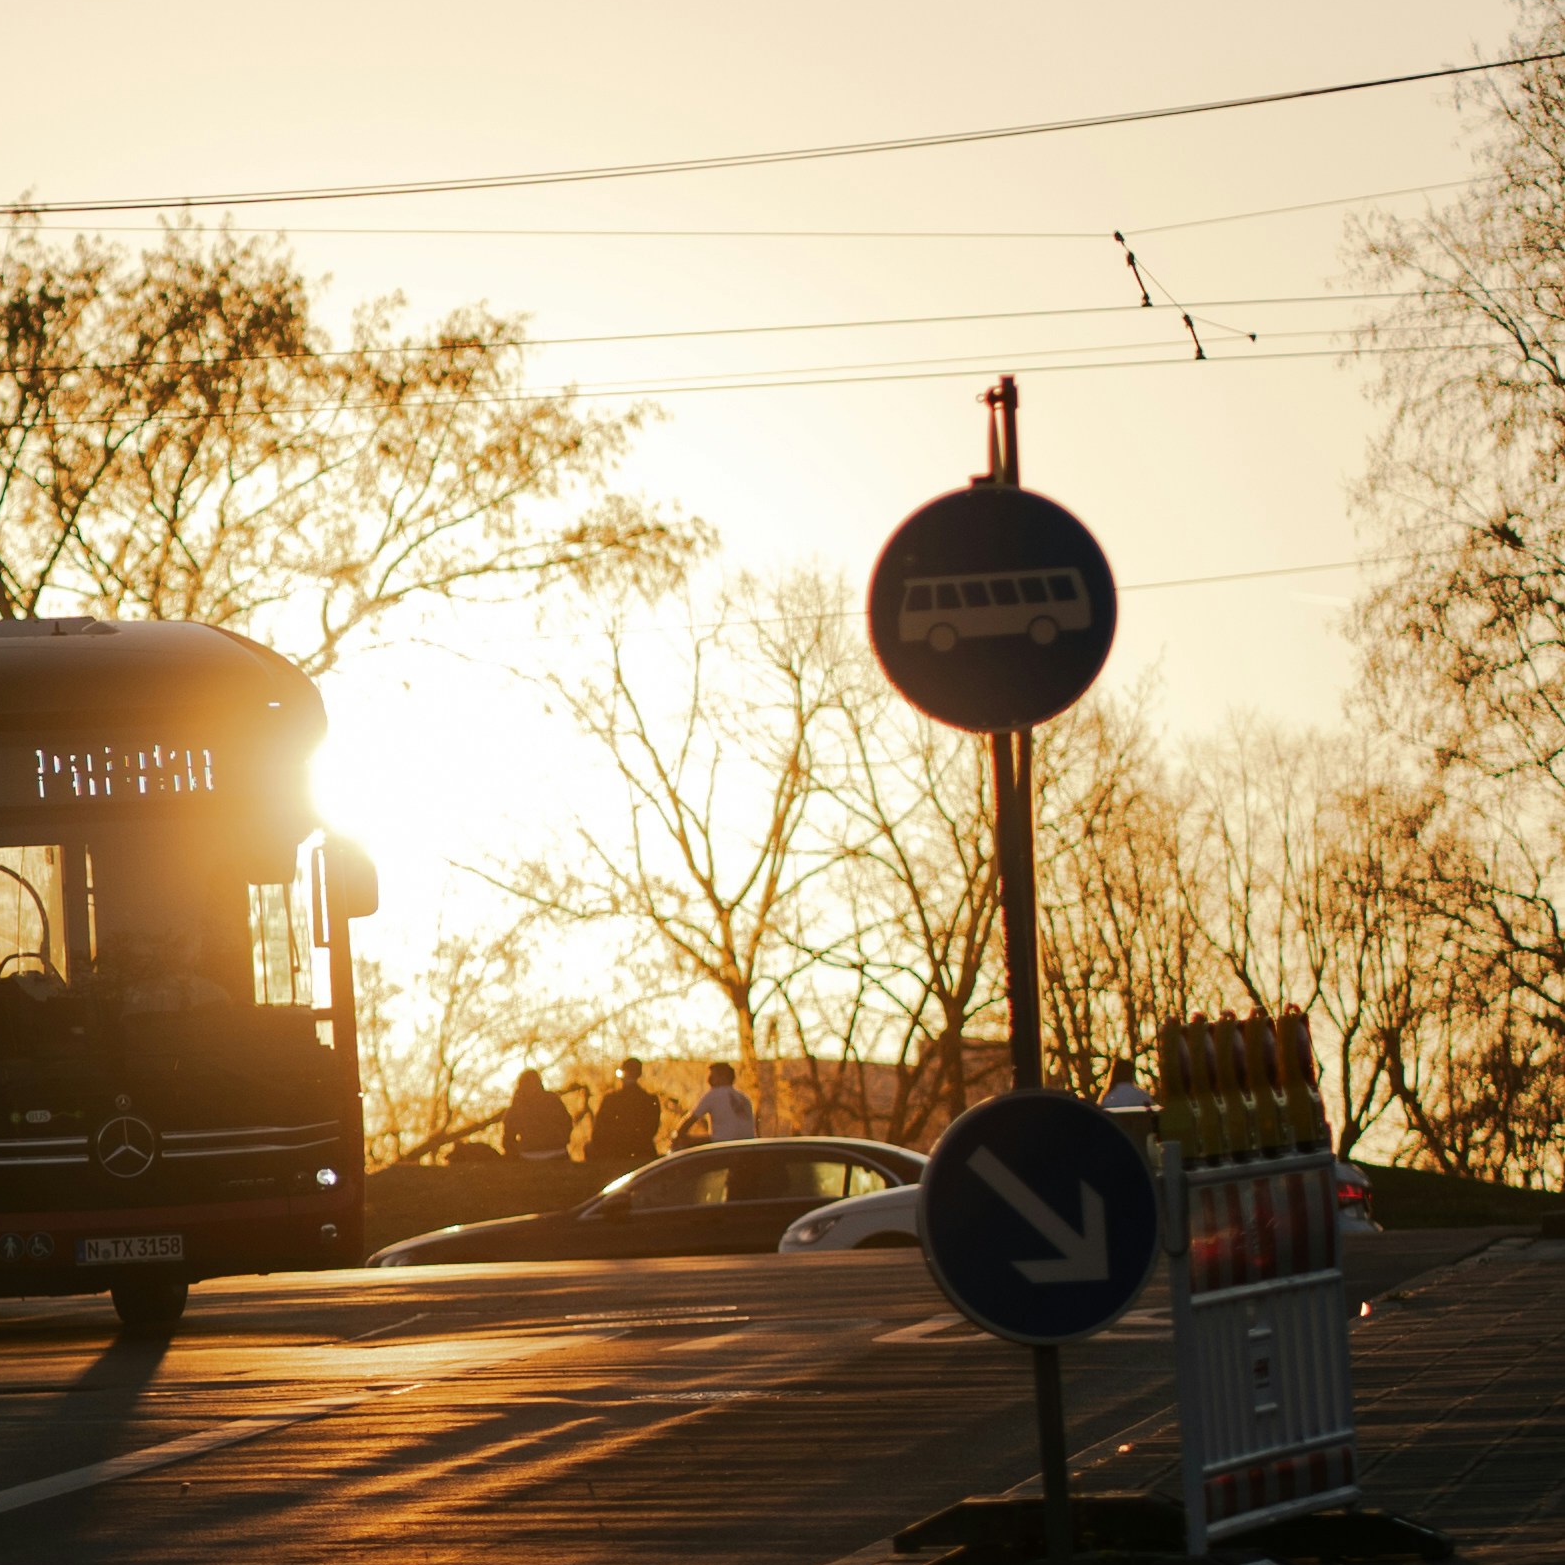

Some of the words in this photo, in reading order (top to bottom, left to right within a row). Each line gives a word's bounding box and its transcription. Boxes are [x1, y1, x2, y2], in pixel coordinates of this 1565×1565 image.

[87, 1241, 99, 1259] N
[111, 1239, 134, 1258] TX
[136, 1237, 181, 1256] 3158
